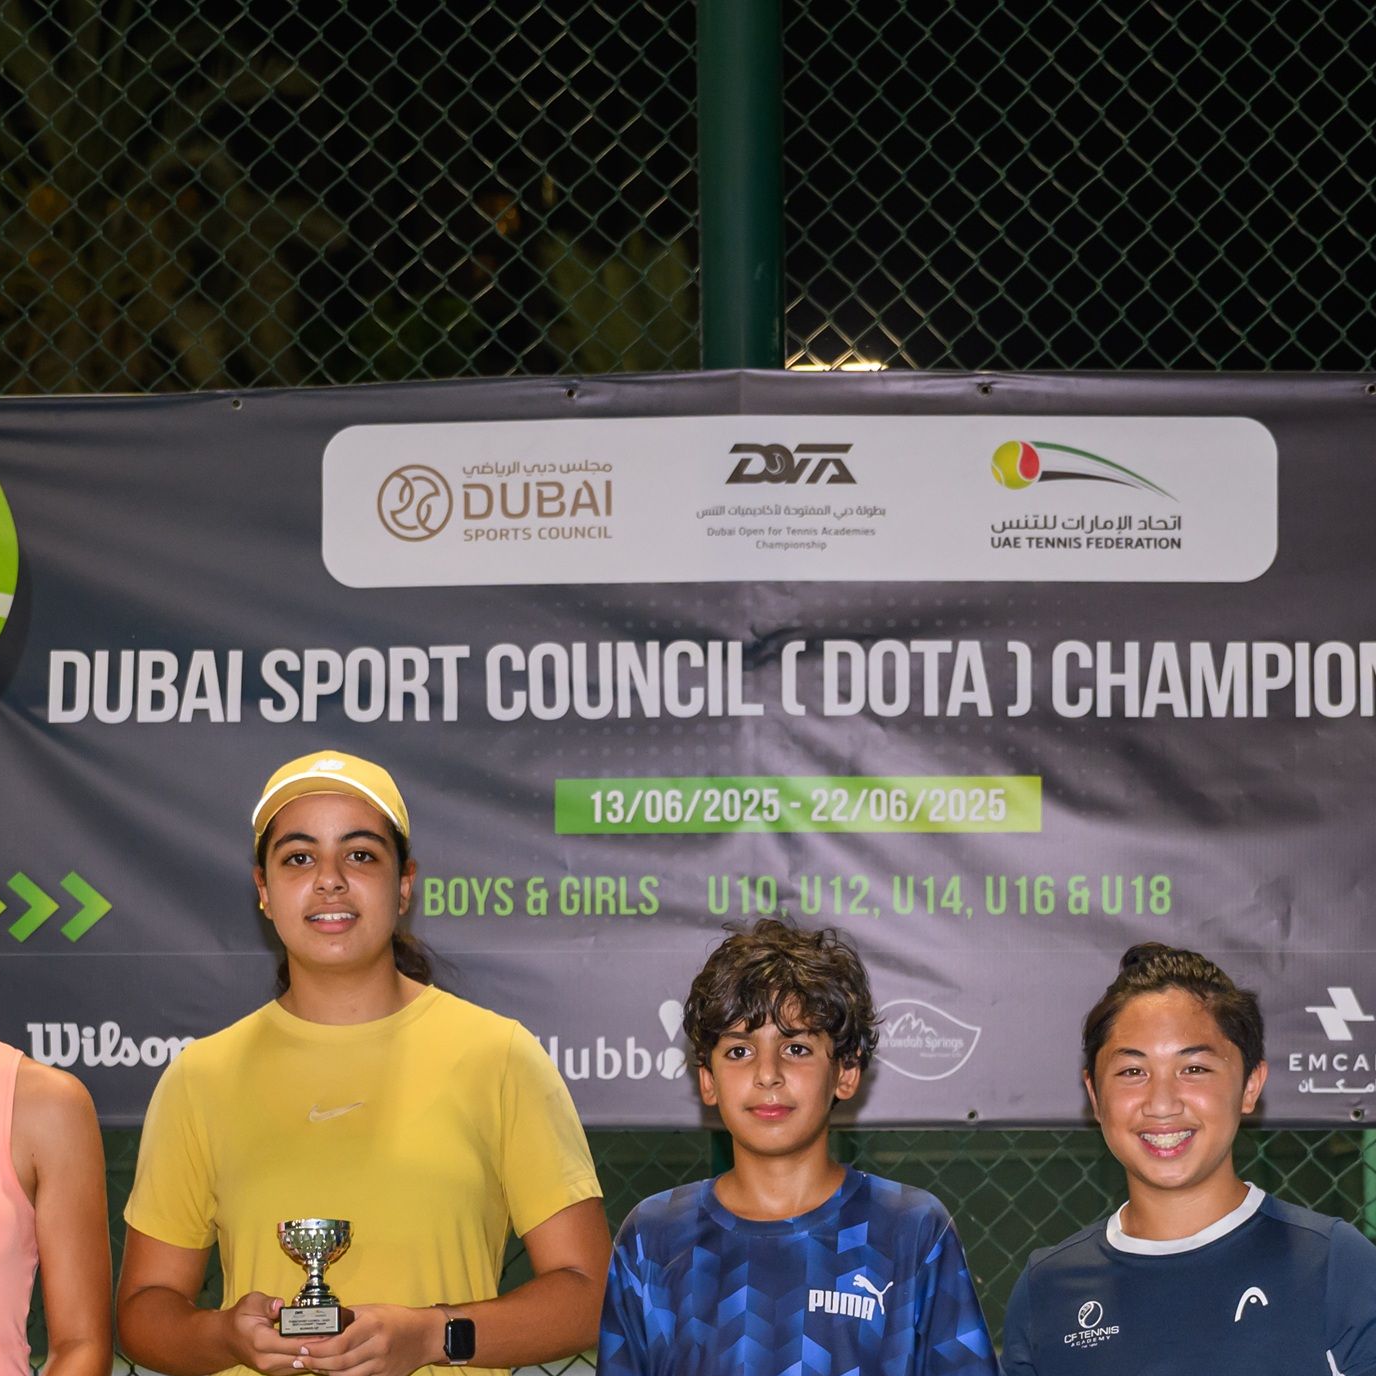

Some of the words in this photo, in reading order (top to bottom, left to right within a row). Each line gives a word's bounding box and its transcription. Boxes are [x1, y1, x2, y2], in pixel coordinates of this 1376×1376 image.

[462, 461, 520, 478] الرياضي
[523, 460, 557, 477] دبي
[559, 459, 613, 475] مجلس
[462, 479, 613, 521] DUBAI
[783, 505, 831, 518] المفتوحة
[833, 506, 854, 520] دبي
[856, 506, 886, 518] بطولة
[991, 514, 1057, 534] للتنس
[1061, 515, 1132, 535] الإمارات
[1137, 515, 1182, 531] اتحاد
[463, 527, 532, 542] SPORTS
[538, 526, 613, 541] COUNCIL
[707, 526, 736, 537] Dubai
[739, 526, 765, 539] Open
[768, 526, 782, 537] for
[786, 526, 818, 537] Tennis
[821, 526, 876, 537] Academies
[755, 540, 827, 551] Championship
[991, 536, 1021, 549] UAE
[1023, 536, 1082, 549] TENNIS
[1087, 536, 1182, 550] FEDERATION
[48, 648, 239, 725] DUBAI
[259, 645, 470, 723] SPORT
[485, 639, 764, 719] COUNCIL
[823, 640, 994, 718] DOTA
[590, 789, 781, 824] 13/06/2025
[810, 788, 1006, 823] 22/06/2025
[424, 877, 515, 917] BOYS
[525, 877, 549, 916] &
[559, 876, 660, 916] GIRLS
[707, 875, 789, 919] U10,
[800, 875, 881, 919] U12,
[892, 875, 974, 919] U14,
[985, 875, 1055, 916] U16
[1067, 875, 1090, 915] &
[1101, 874, 1172, 915] U18
[925, 1036, 964, 1053] Springs
[809, 1289, 876, 1321] PUMA
[1064, 1332, 1078, 1344] CF
[1078, 1325, 1120, 1340] TENNIS
